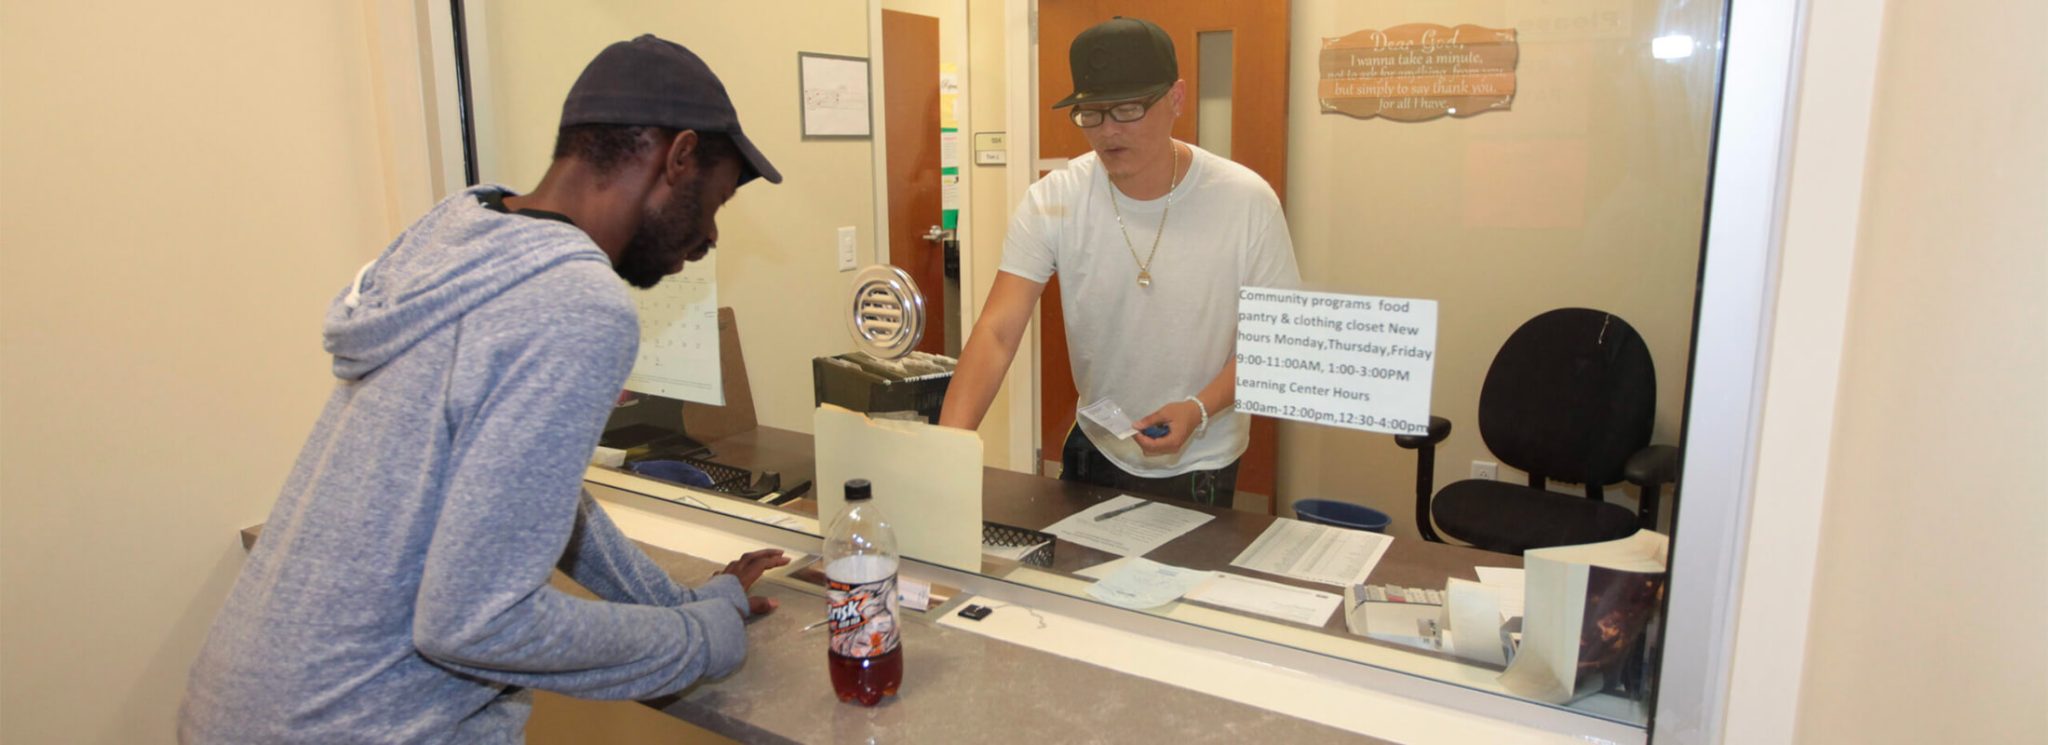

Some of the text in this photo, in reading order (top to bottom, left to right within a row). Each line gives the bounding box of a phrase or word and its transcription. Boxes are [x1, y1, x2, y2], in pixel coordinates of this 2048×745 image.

[1370, 31, 1414, 52] Dear
[1357, 55, 1395, 66] wanna
[1398, 51, 1424, 65] take
[1425, 55, 1433, 64] a
[1335, 82, 1353, 96] but
[1357, 80, 1393, 98] simply
[1397, 84, 1408, 94] to
[1411, 85, 1429, 96] say
[1433, 79, 1469, 94] thank
[1376, 97, 1394, 113] for
[1397, 97, 1410, 109] all
[1239, 289, 1410, 313] Community programs food
[1238, 311, 1420, 336] pantry & clothing closet New
[1237, 330, 1432, 361] hours Monday,Thursday,Friday
[1236, 354, 1410, 381] 9:00-11:00AM, 1:00-3:00PM
[1236, 377, 1371, 401] Learning Center Hours
